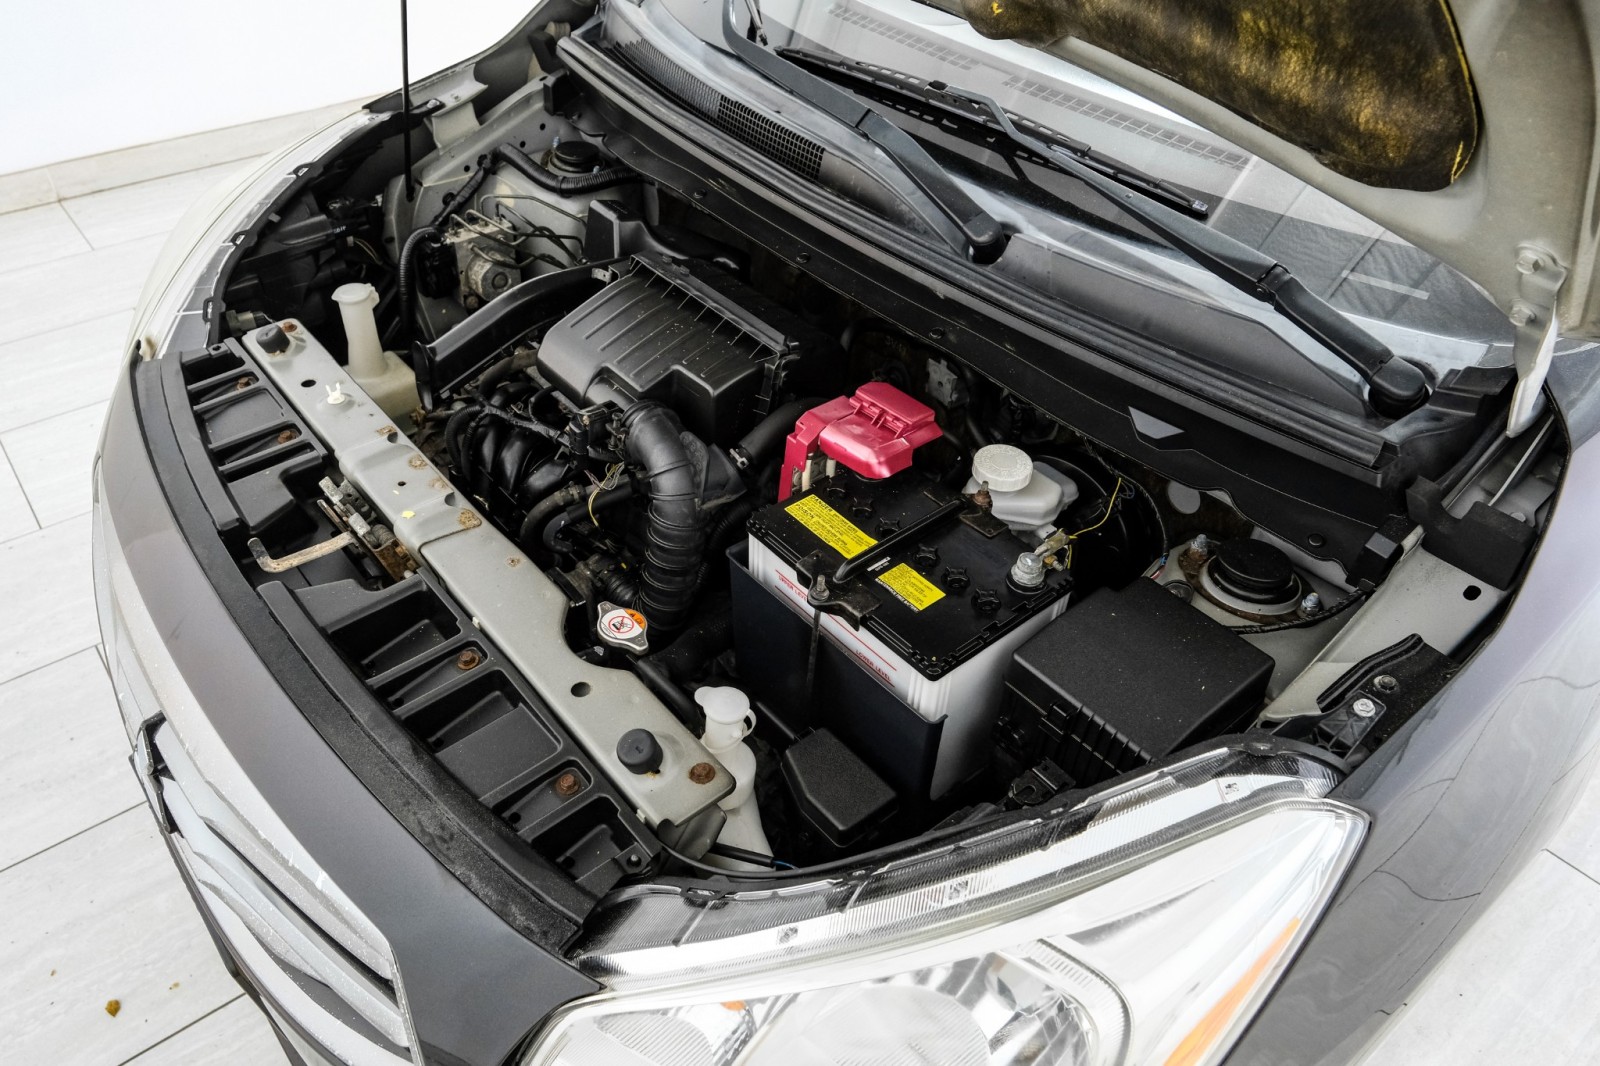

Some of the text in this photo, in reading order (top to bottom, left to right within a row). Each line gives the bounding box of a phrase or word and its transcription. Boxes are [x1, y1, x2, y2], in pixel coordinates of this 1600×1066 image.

[812, 495, 833, 513] DANGER
[779, 575, 793, 591] UPPER
[856, 650, 891, 681] LOWER LEVEL
